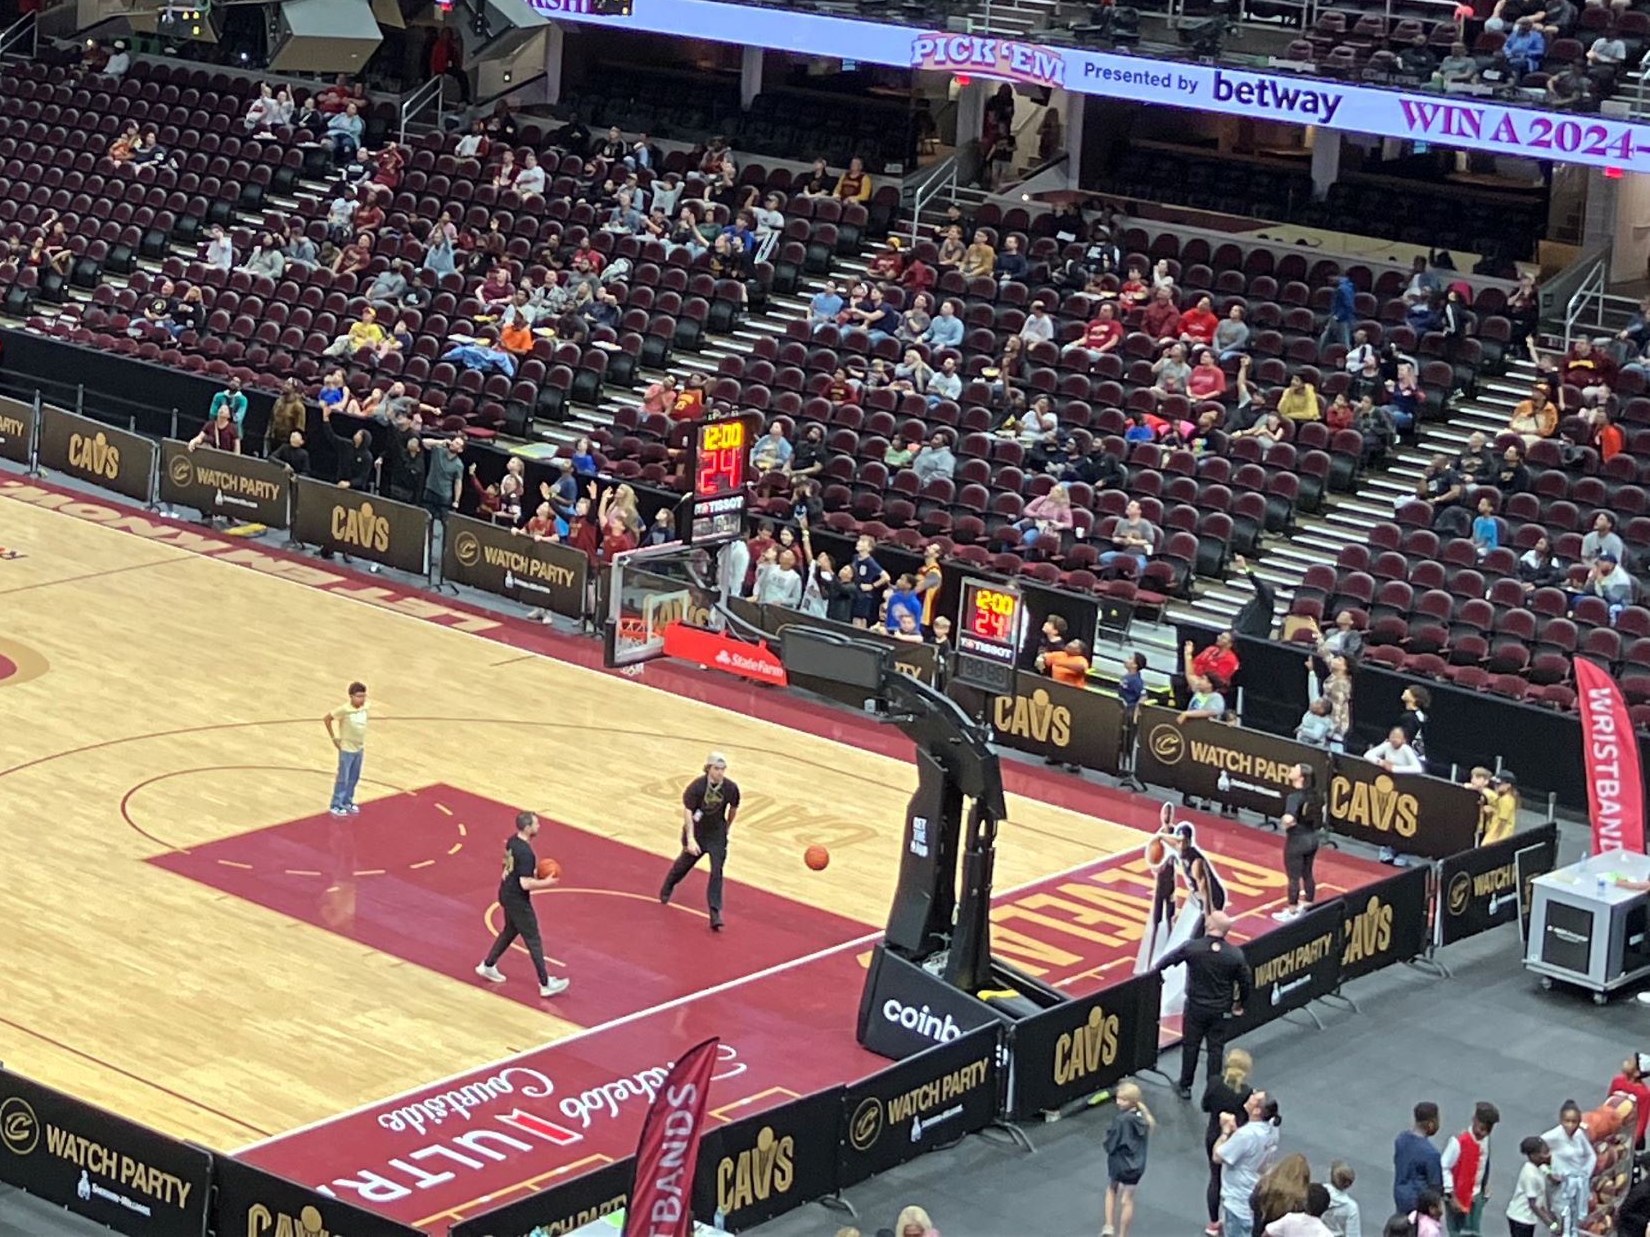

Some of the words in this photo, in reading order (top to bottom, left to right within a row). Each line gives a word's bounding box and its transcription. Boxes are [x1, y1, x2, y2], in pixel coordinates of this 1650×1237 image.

[911, 33, 992, 65] PICK
[1083, 61, 1172, 89] Presented
[1179, 74, 1199, 95] by
[1212, 70, 1344, 123] betway
[1399, 99, 1481, 139] WIN
[1496, 113, 1520, 142] A
[68, 431, 119, 480] CAVS
[703, 421, 743, 451] 12:00
[196, 466, 239, 491] WATCH
[239, 475, 281, 502] PARTY
[698, 448, 741, 495] 24
[330, 501, 390, 554] CAVS
[708, 495, 745, 514] TISSOT
[483, 546, 529, 576] WATCH
[529, 557, 576, 589] PARTY
[973, 611, 1007, 638] 24
[976, 590, 1014, 616] 12:00
[972, 642, 1012, 660] TISSOT
[994, 688, 1071, 748] CAVS
[1190, 740, 1253, 773] WATCH
[1331, 774, 1419, 838] CAVS
[1254, 954, 1296, 990] WATCH
[1294, 932, 1333, 970] PARTY
[1052, 1005, 1120, 1087] CAVS
[377, 1068, 556, 1134] Courtside
[886, 1084, 943, 1126] WATCH
[941, 1056, 989, 1103] PARTY
[46, 1124, 117, 1179] WATCH
[121, 1155, 192, 1210] PARTY
[716, 1125, 795, 1215] CAVS
